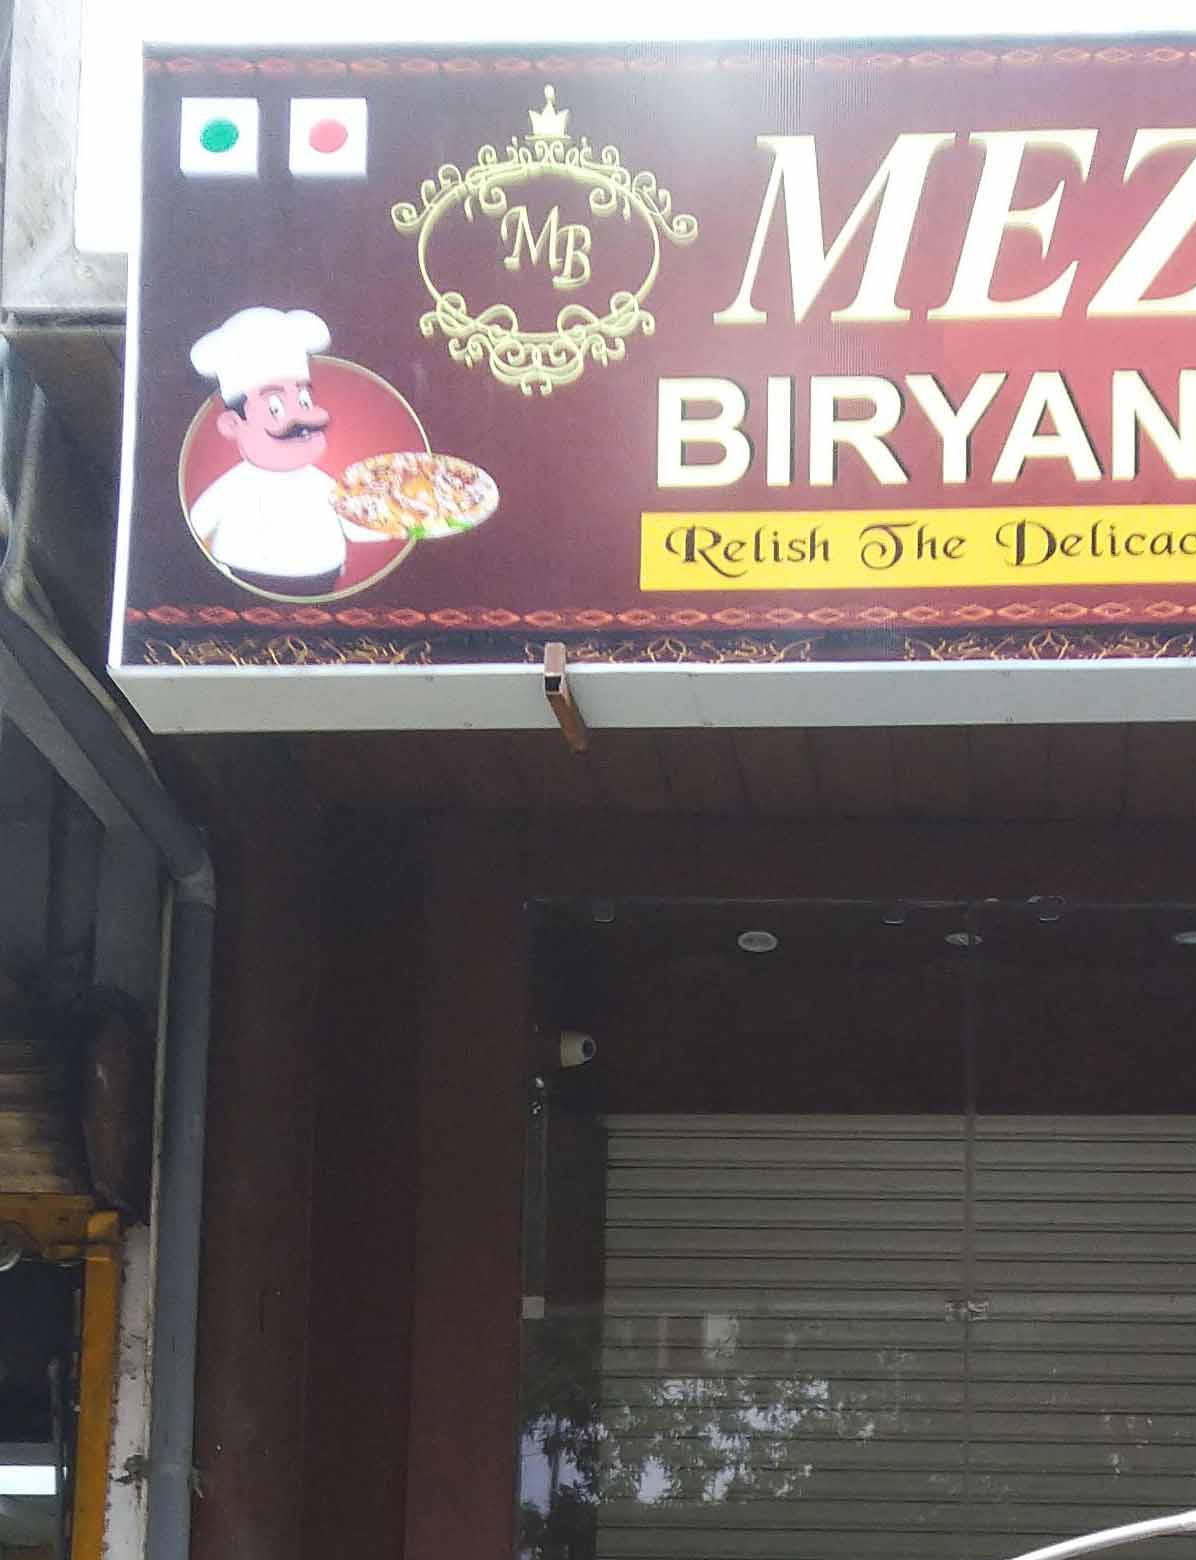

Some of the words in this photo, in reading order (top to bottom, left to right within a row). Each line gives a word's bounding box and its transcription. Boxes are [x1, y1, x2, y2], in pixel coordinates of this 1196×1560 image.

[500, 204, 592, 289] MB
[664, 525, 830, 578] Relish
[858, 521, 967, 571] The
